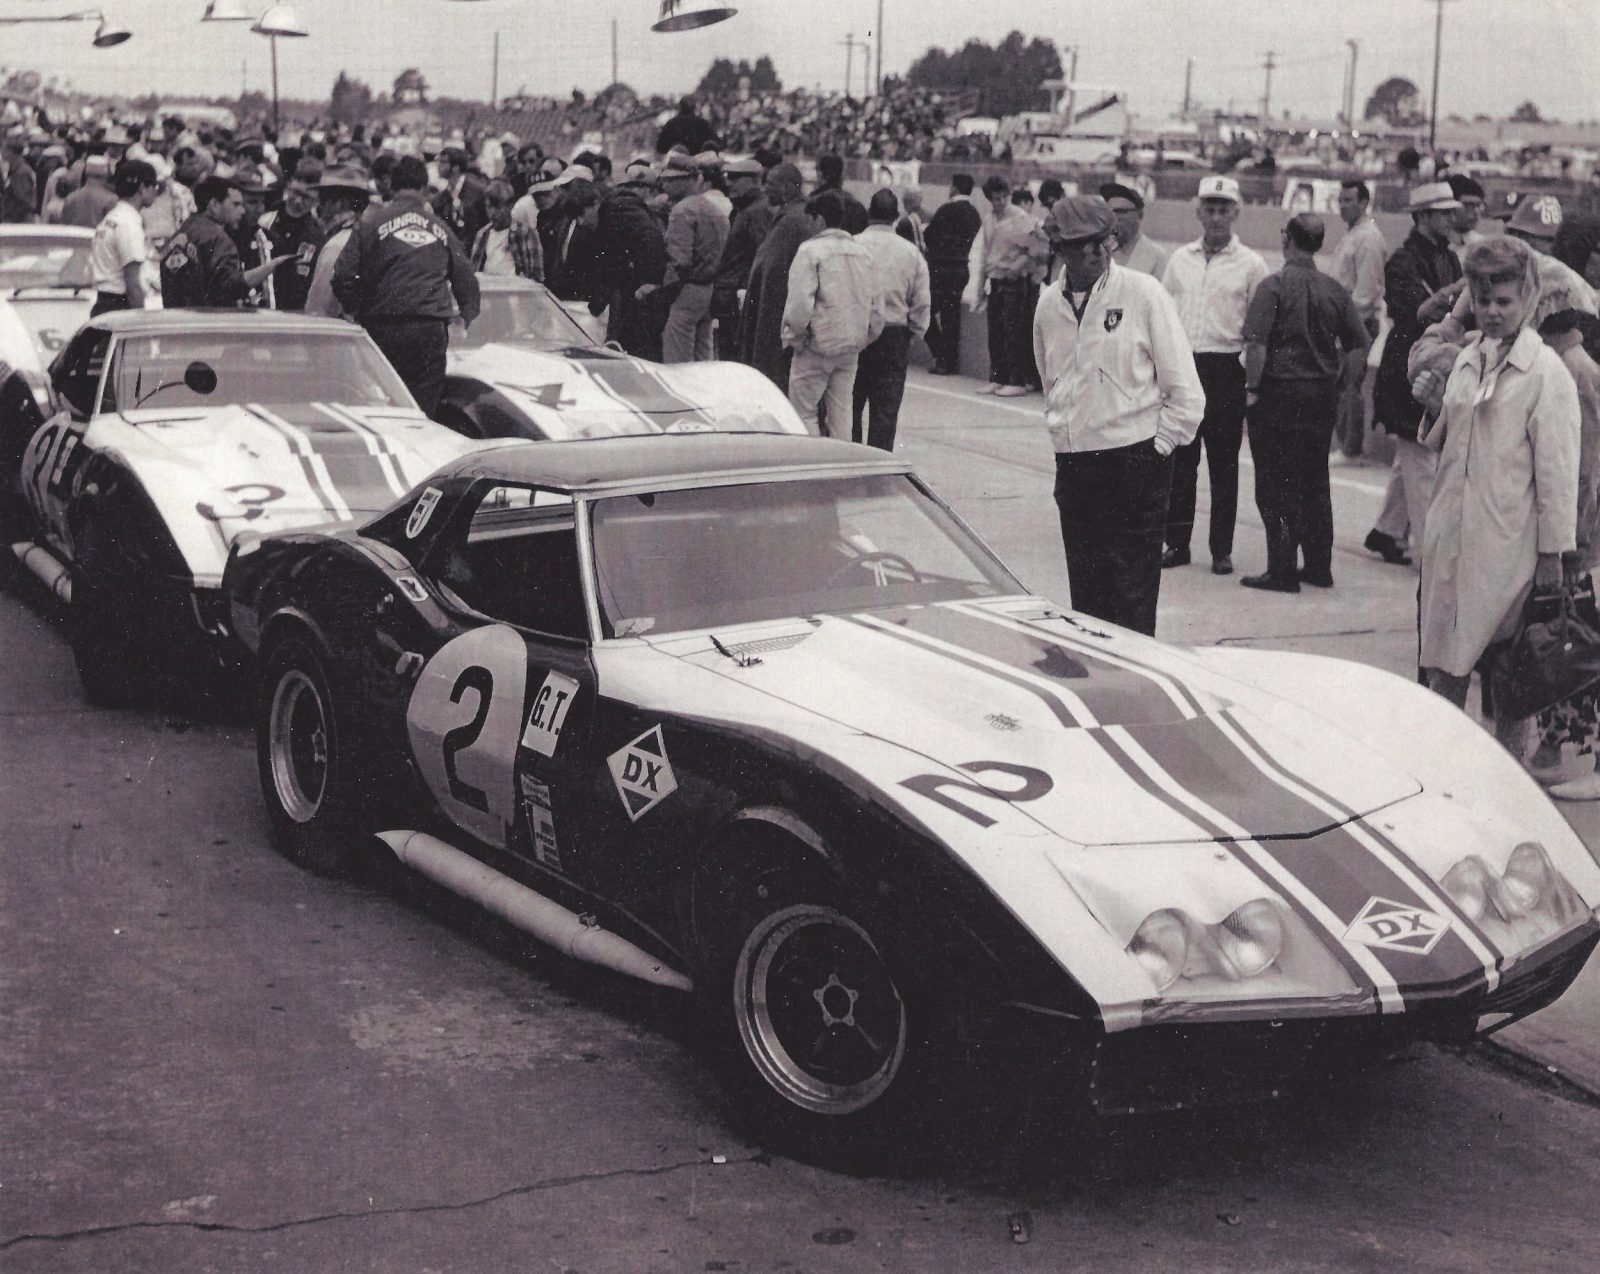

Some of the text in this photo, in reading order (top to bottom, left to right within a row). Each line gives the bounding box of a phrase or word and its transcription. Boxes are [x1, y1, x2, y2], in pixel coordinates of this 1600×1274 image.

[378, 212, 429, 241] SUNRAY
[195, 483, 286, 522] 3
[530, 685, 569, 736] G.T.
[442, 665, 494, 814] 2
[621, 752, 664, 793] DX
[896, 760, 1054, 829] 2
[1366, 914, 1435, 939] DX
